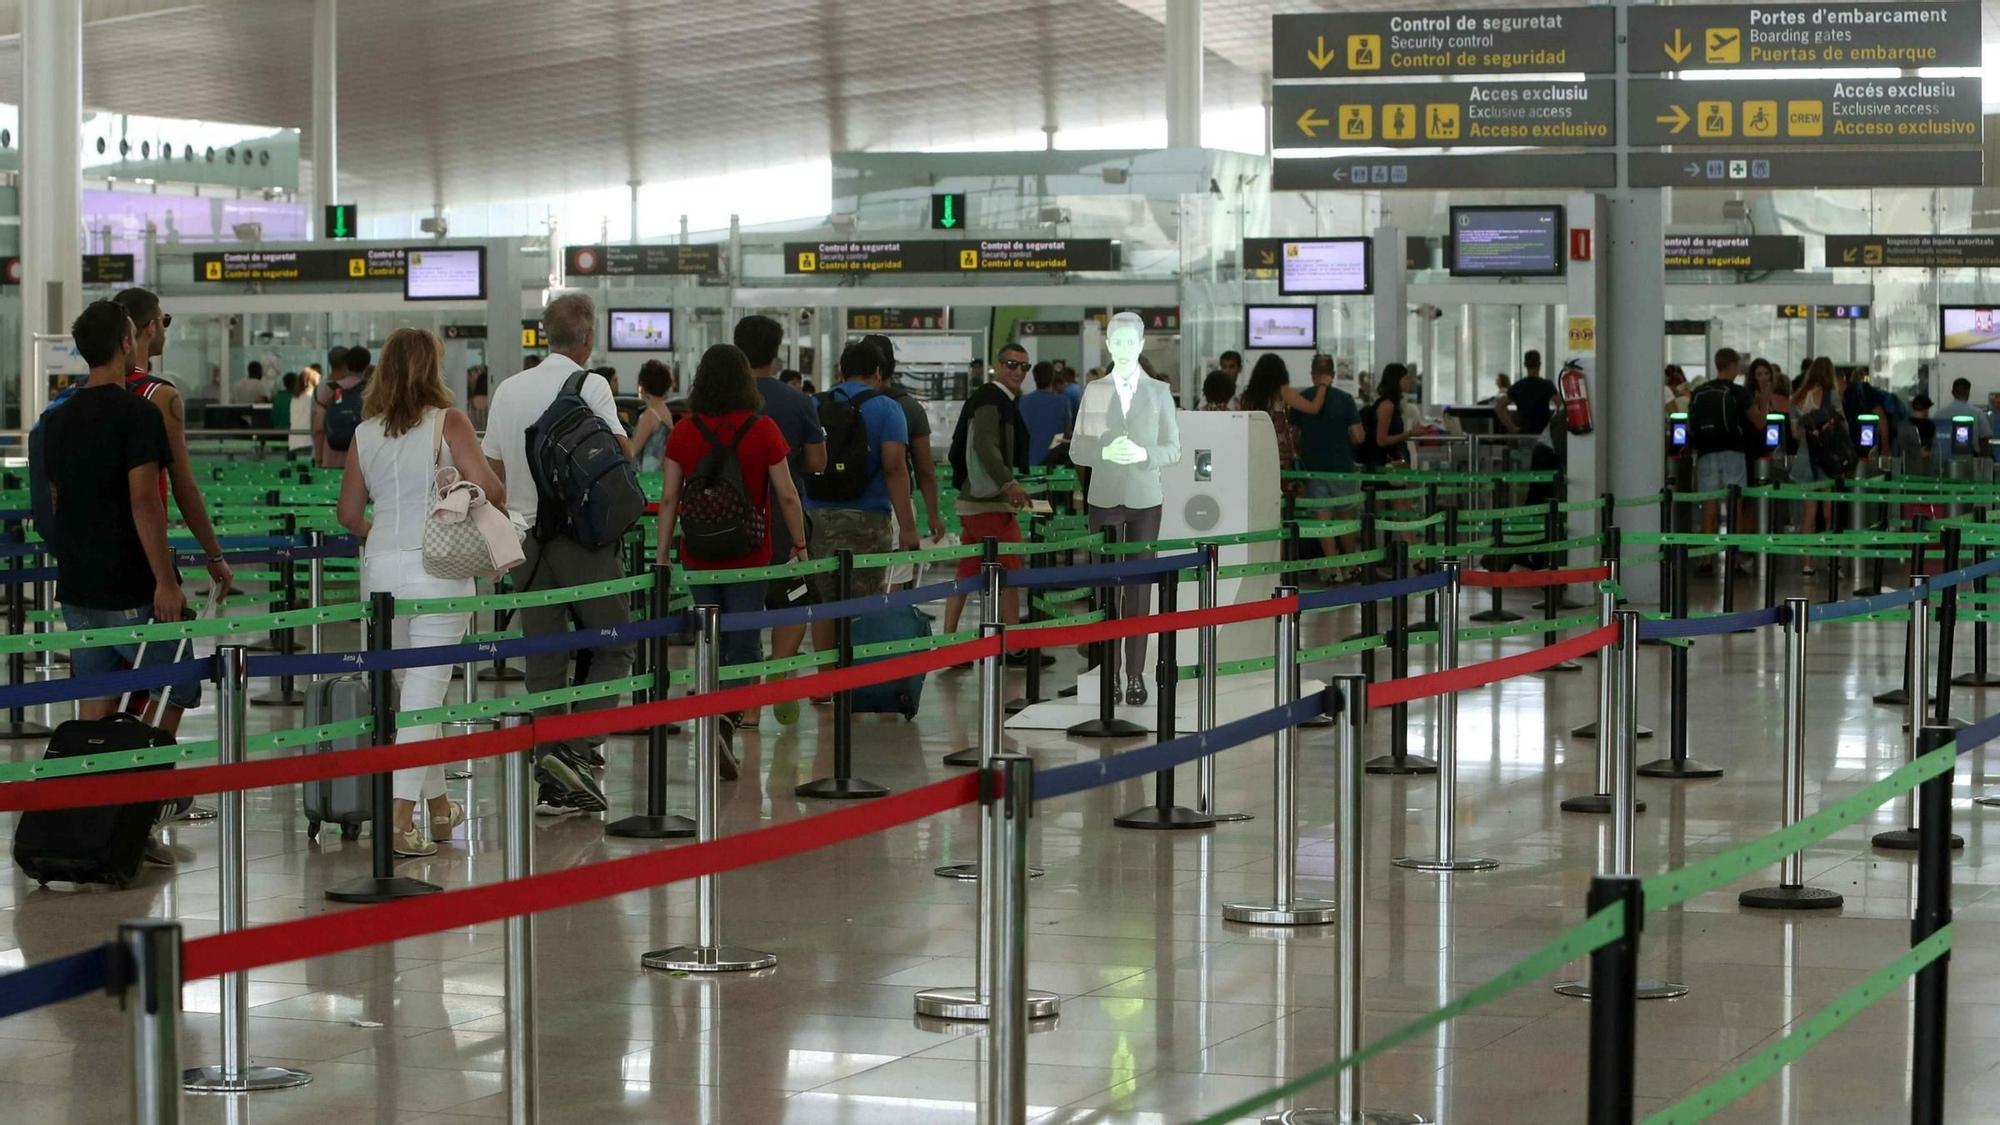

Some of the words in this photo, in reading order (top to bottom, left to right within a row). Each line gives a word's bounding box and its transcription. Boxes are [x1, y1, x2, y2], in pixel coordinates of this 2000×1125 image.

[1390, 16, 1451, 32] Control
[1456, 16, 1477, 30] de
[1483, 14, 1563, 32] seguretat
[1750, 9, 1806, 25] Portes
[1812, 8, 1948, 23] d'embarcament
[1391, 34, 1444, 50] Security
[1448, 33, 1494, 48] control
[1750, 29, 1810, 44] Boarding
[1815, 29, 1852, 44] gates
[1391, 52, 1451, 67] Control
[1457, 52, 1477, 66] de
[1483, 50, 1567, 67] seguridad
[1750, 46, 1817, 62] Puertas
[1823, 46, 1844, 60] de
[1850, 44, 1937, 62] embarque
[1522, 84, 1588, 101] exclusiu
[1832, 81, 1884, 98] Accés
[1888, 81, 1955, 97] exclusiu
[1469, 104, 1526, 119] Exclusive
[1528, 106, 1573, 118] access
[1832, 102, 1891, 116] Exclusive
[1894, 103, 1940, 115] access
[1789, 113, 1822, 124] CREW
[1470, 121, 1528, 137] Acceso
[1531, 121, 1608, 137] exclusivo
[1833, 119, 1894, 135] Acceso
[1897, 118, 1976, 135] exclusivo
[818, 243, 848, 252] Control
[849, 243, 860, 252] de
[862, 243, 900, 253] seguretat
[980, 241, 1012, 250] Control
[1012, 241, 1024, 250] de
[1025, 241, 1065, 251] seguretat
[1664, 237, 1691, 247] ontrol
[223, 253, 250, 262] Control
[367, 250, 392, 259] Control
[1664, 256, 1691, 265] ontrol
[819, 261, 849, 270] Control
[850, 260, 860, 269] de
[862, 260, 902, 270] seguridad
[981, 259, 1012, 268] Control
[1013, 259, 1024, 268] de
[1025, 258, 1067, 269] seguridad
